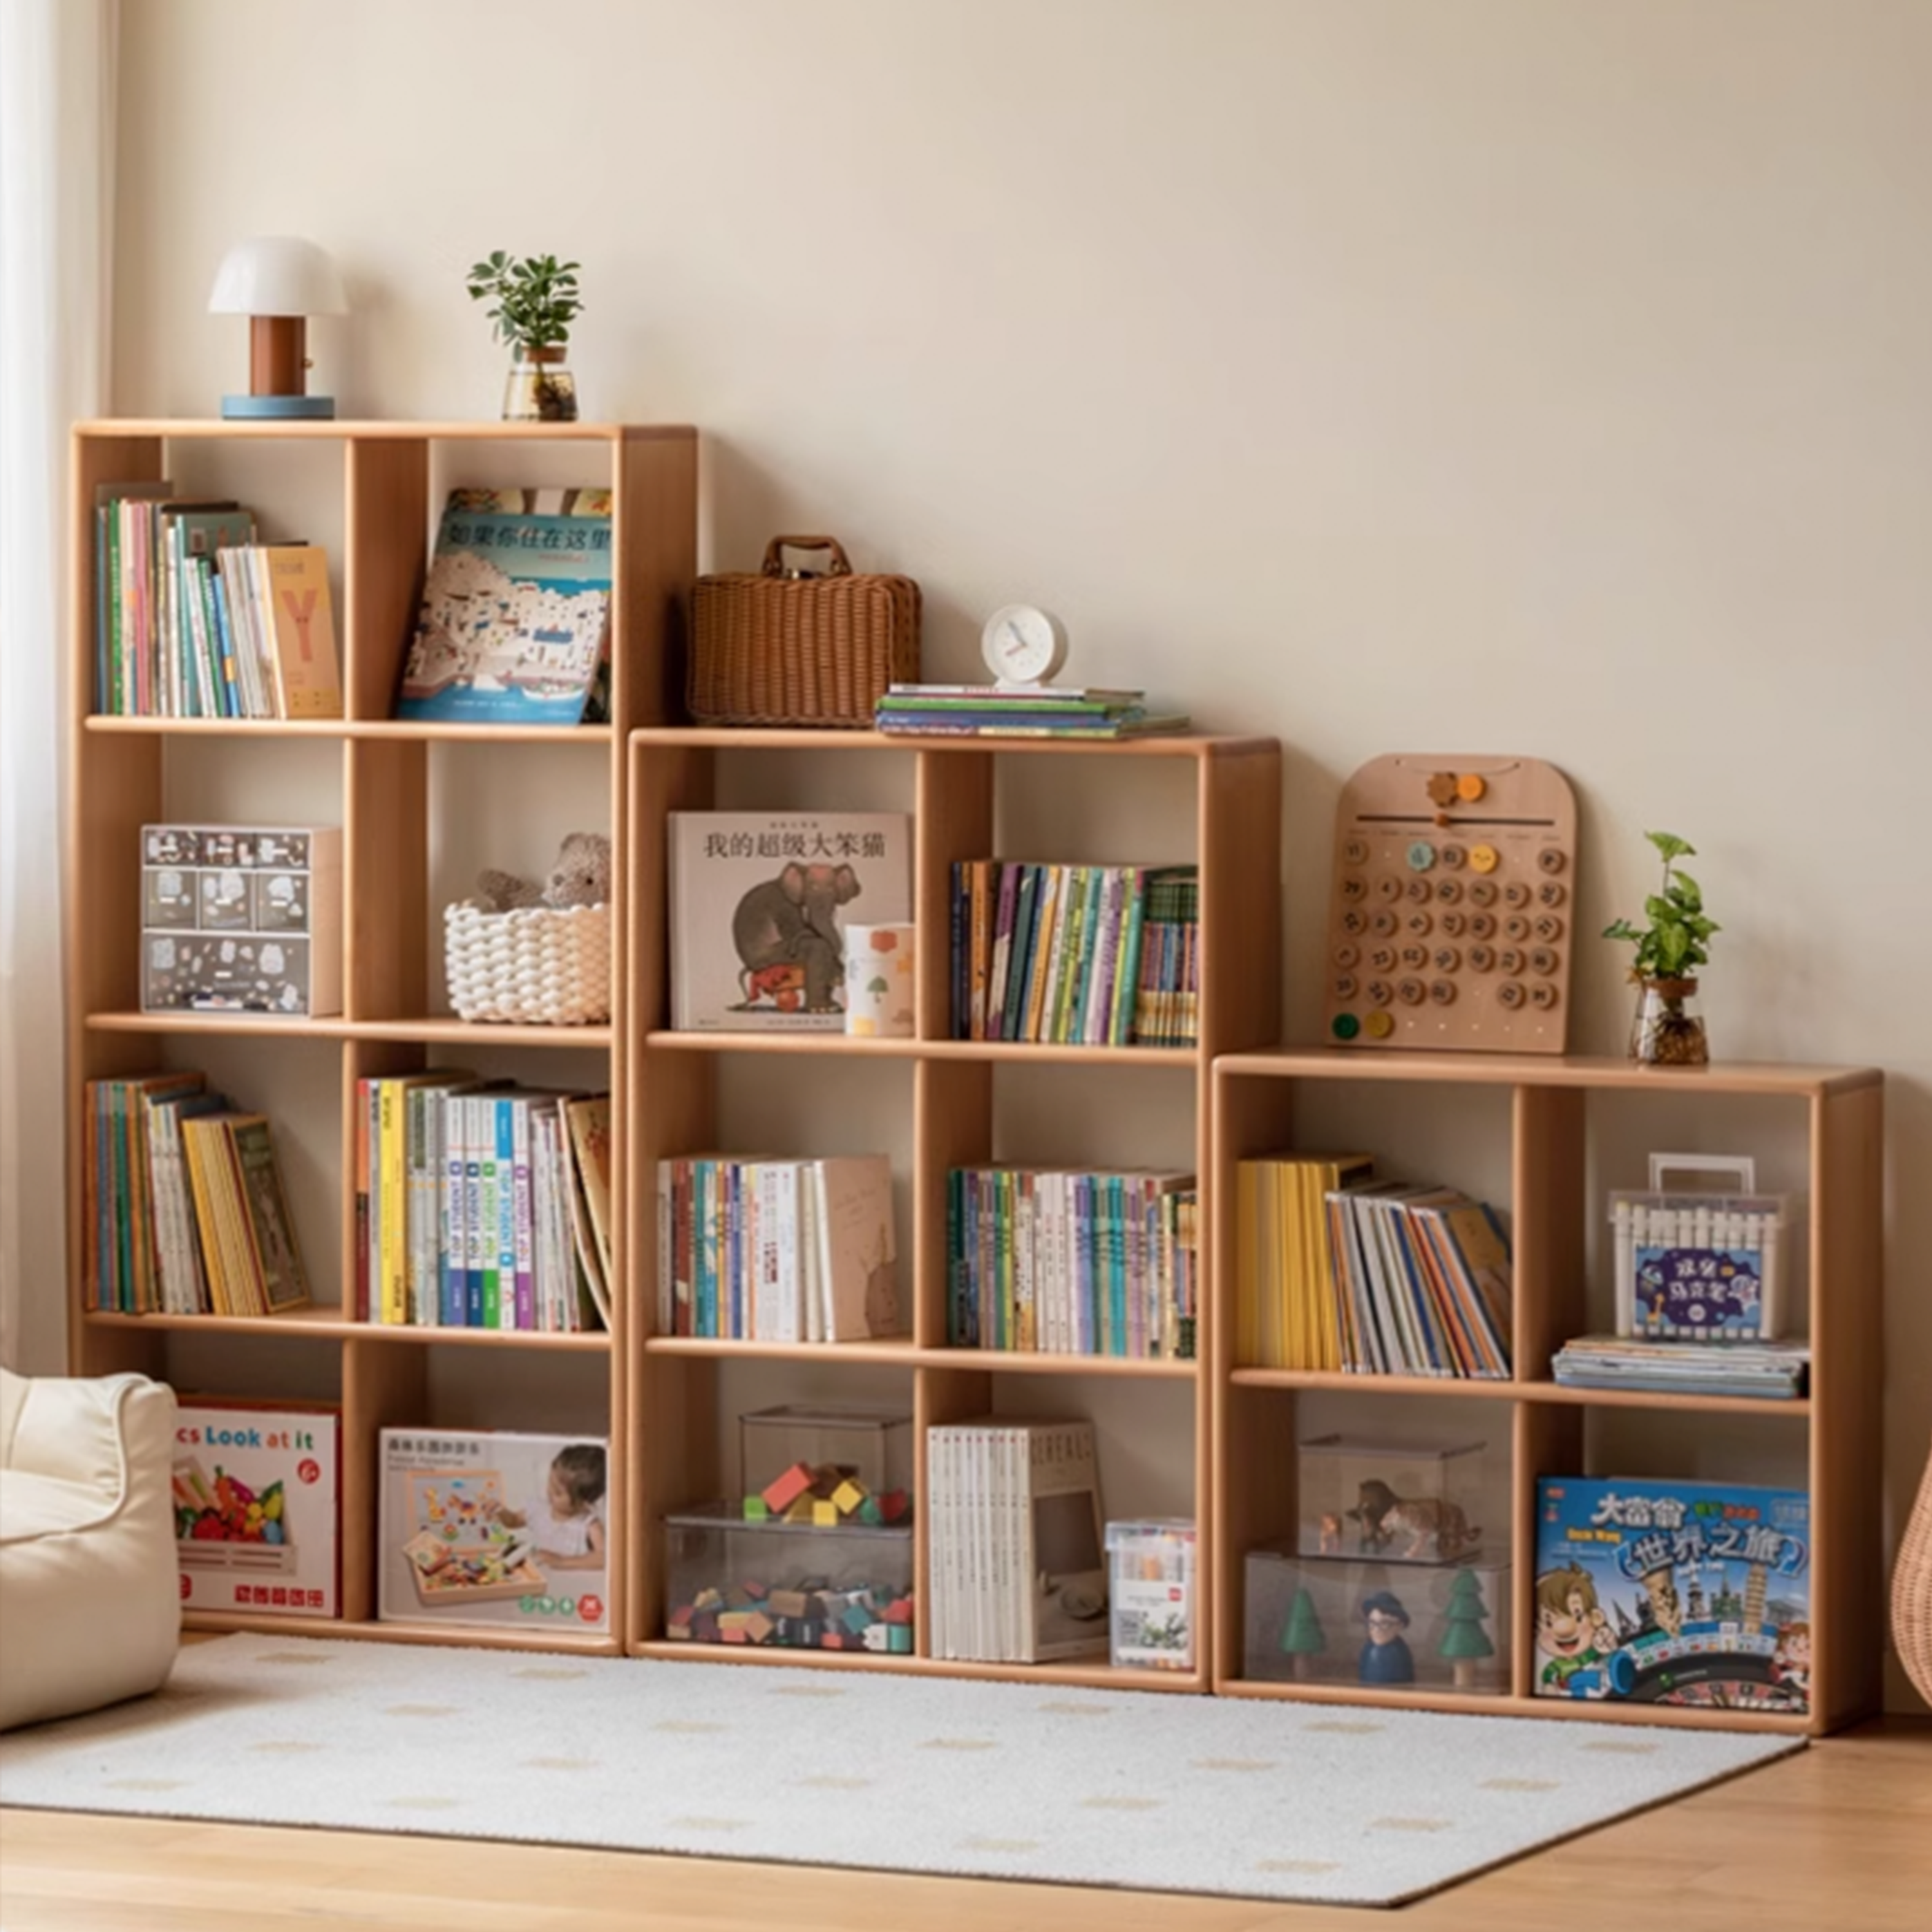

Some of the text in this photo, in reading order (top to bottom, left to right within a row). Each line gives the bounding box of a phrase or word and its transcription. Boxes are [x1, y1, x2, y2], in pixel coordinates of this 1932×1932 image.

[703, 831, 886, 859] 我的超级大笨猫
[176, 1426, 314, 1450] cs Look at it
[1634, 1524, 1781, 1572] 世界之旅
